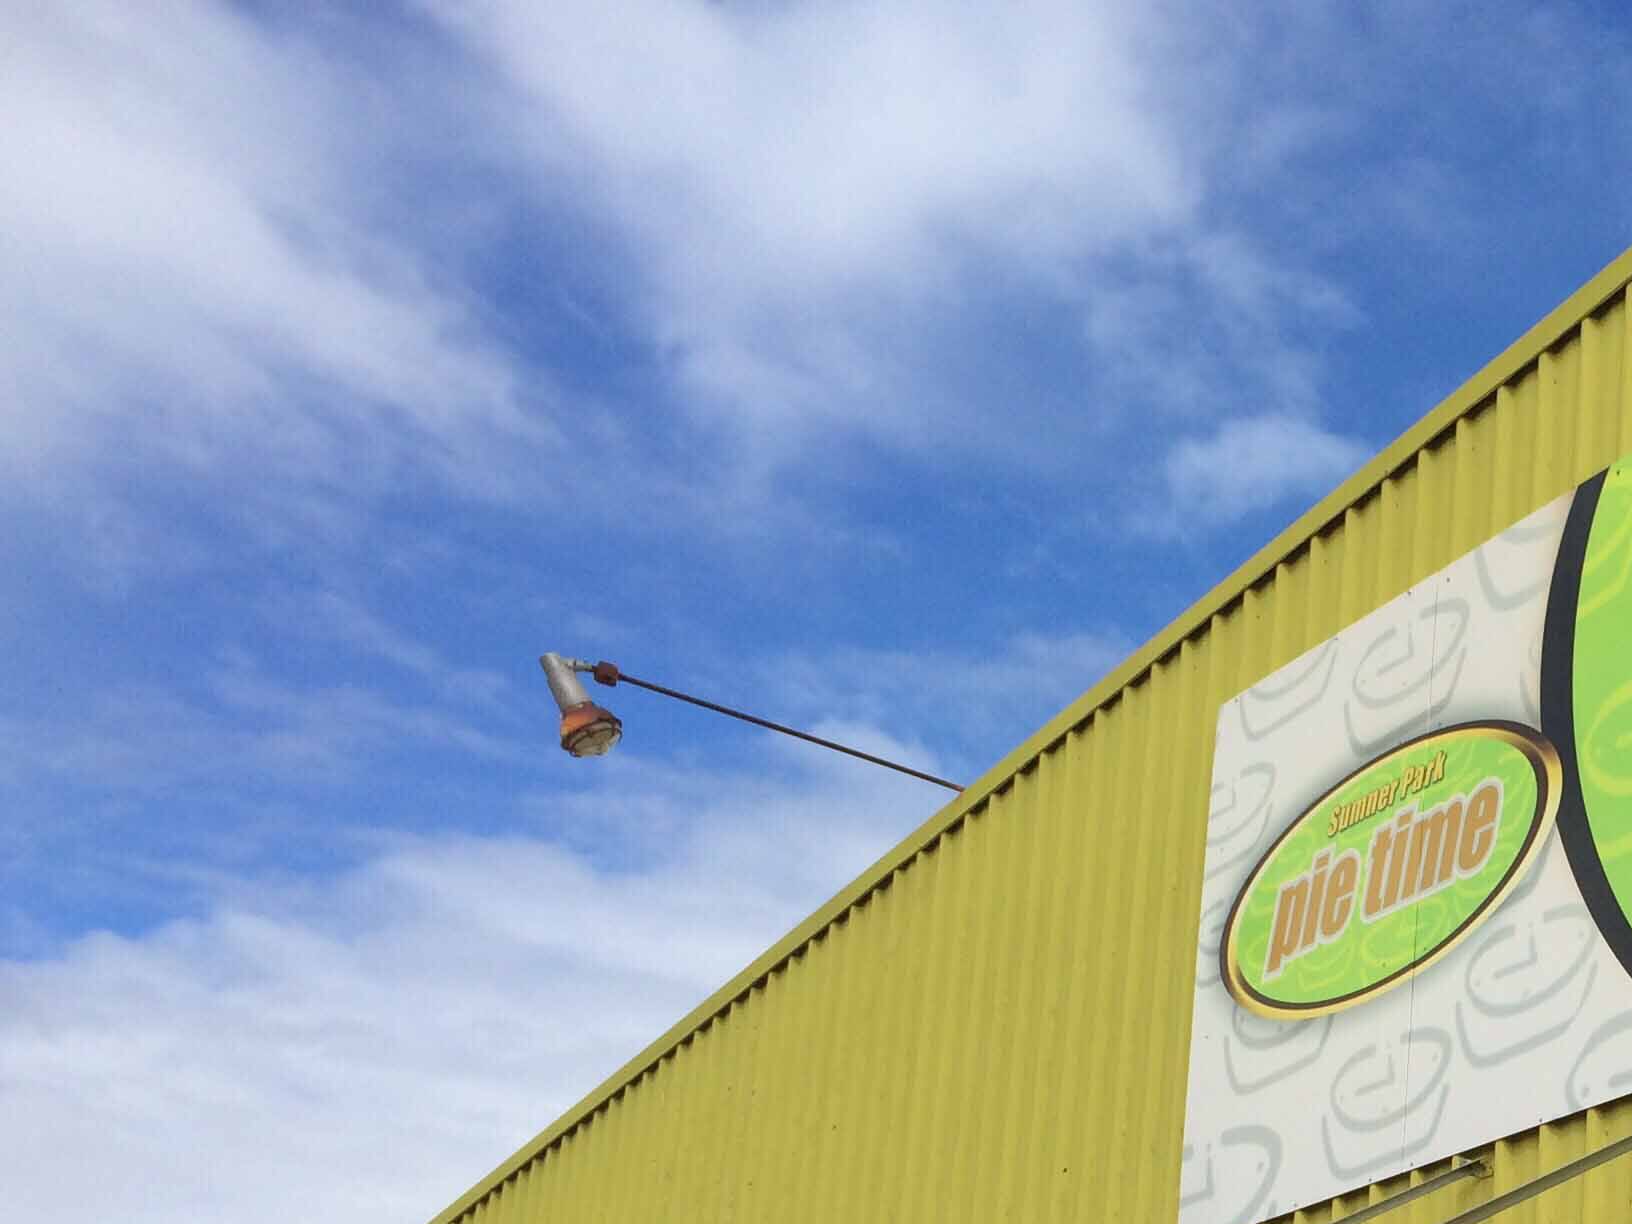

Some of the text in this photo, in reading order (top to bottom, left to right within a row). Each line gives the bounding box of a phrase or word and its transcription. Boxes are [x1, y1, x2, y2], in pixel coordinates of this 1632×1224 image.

[1399, 751, 1447, 800] Park
[1263, 778, 1504, 978] pie time
